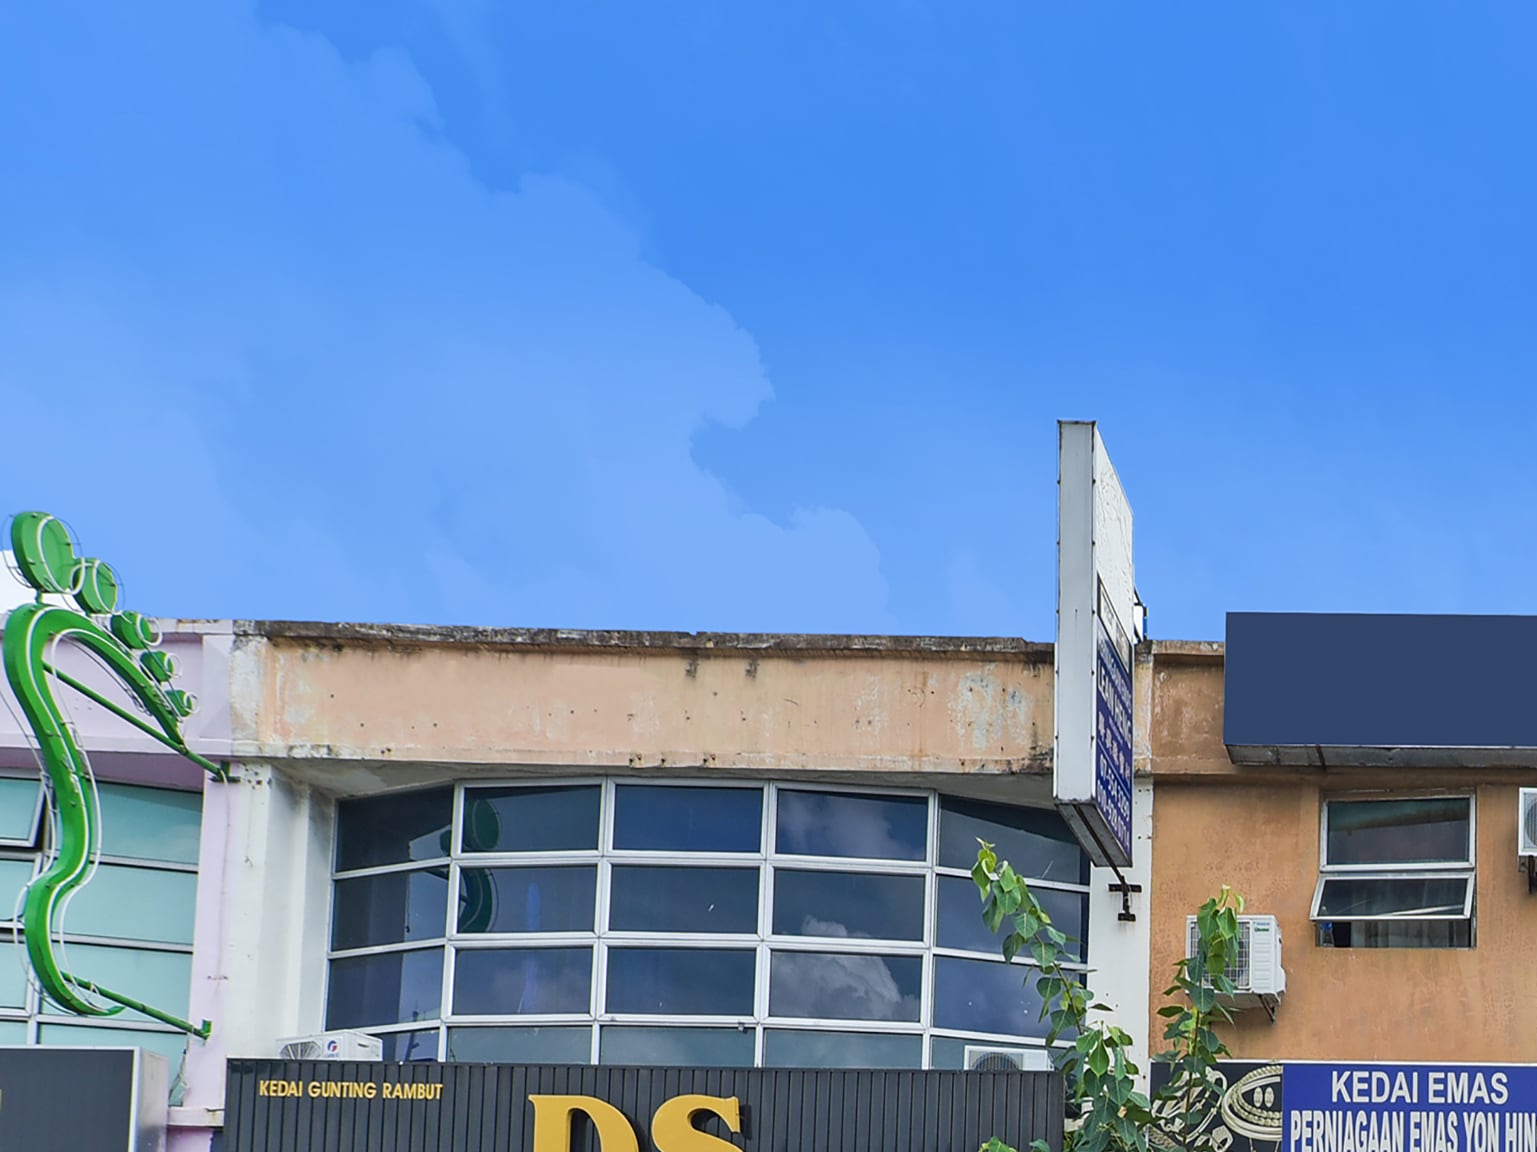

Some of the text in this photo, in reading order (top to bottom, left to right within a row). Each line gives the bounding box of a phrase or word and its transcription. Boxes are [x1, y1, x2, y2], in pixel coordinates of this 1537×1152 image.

[259, 1080, 444, 1100] KEDAI GUNTING RAMBUT
[1331, 1071, 1509, 1104] KEDAI EMAS
